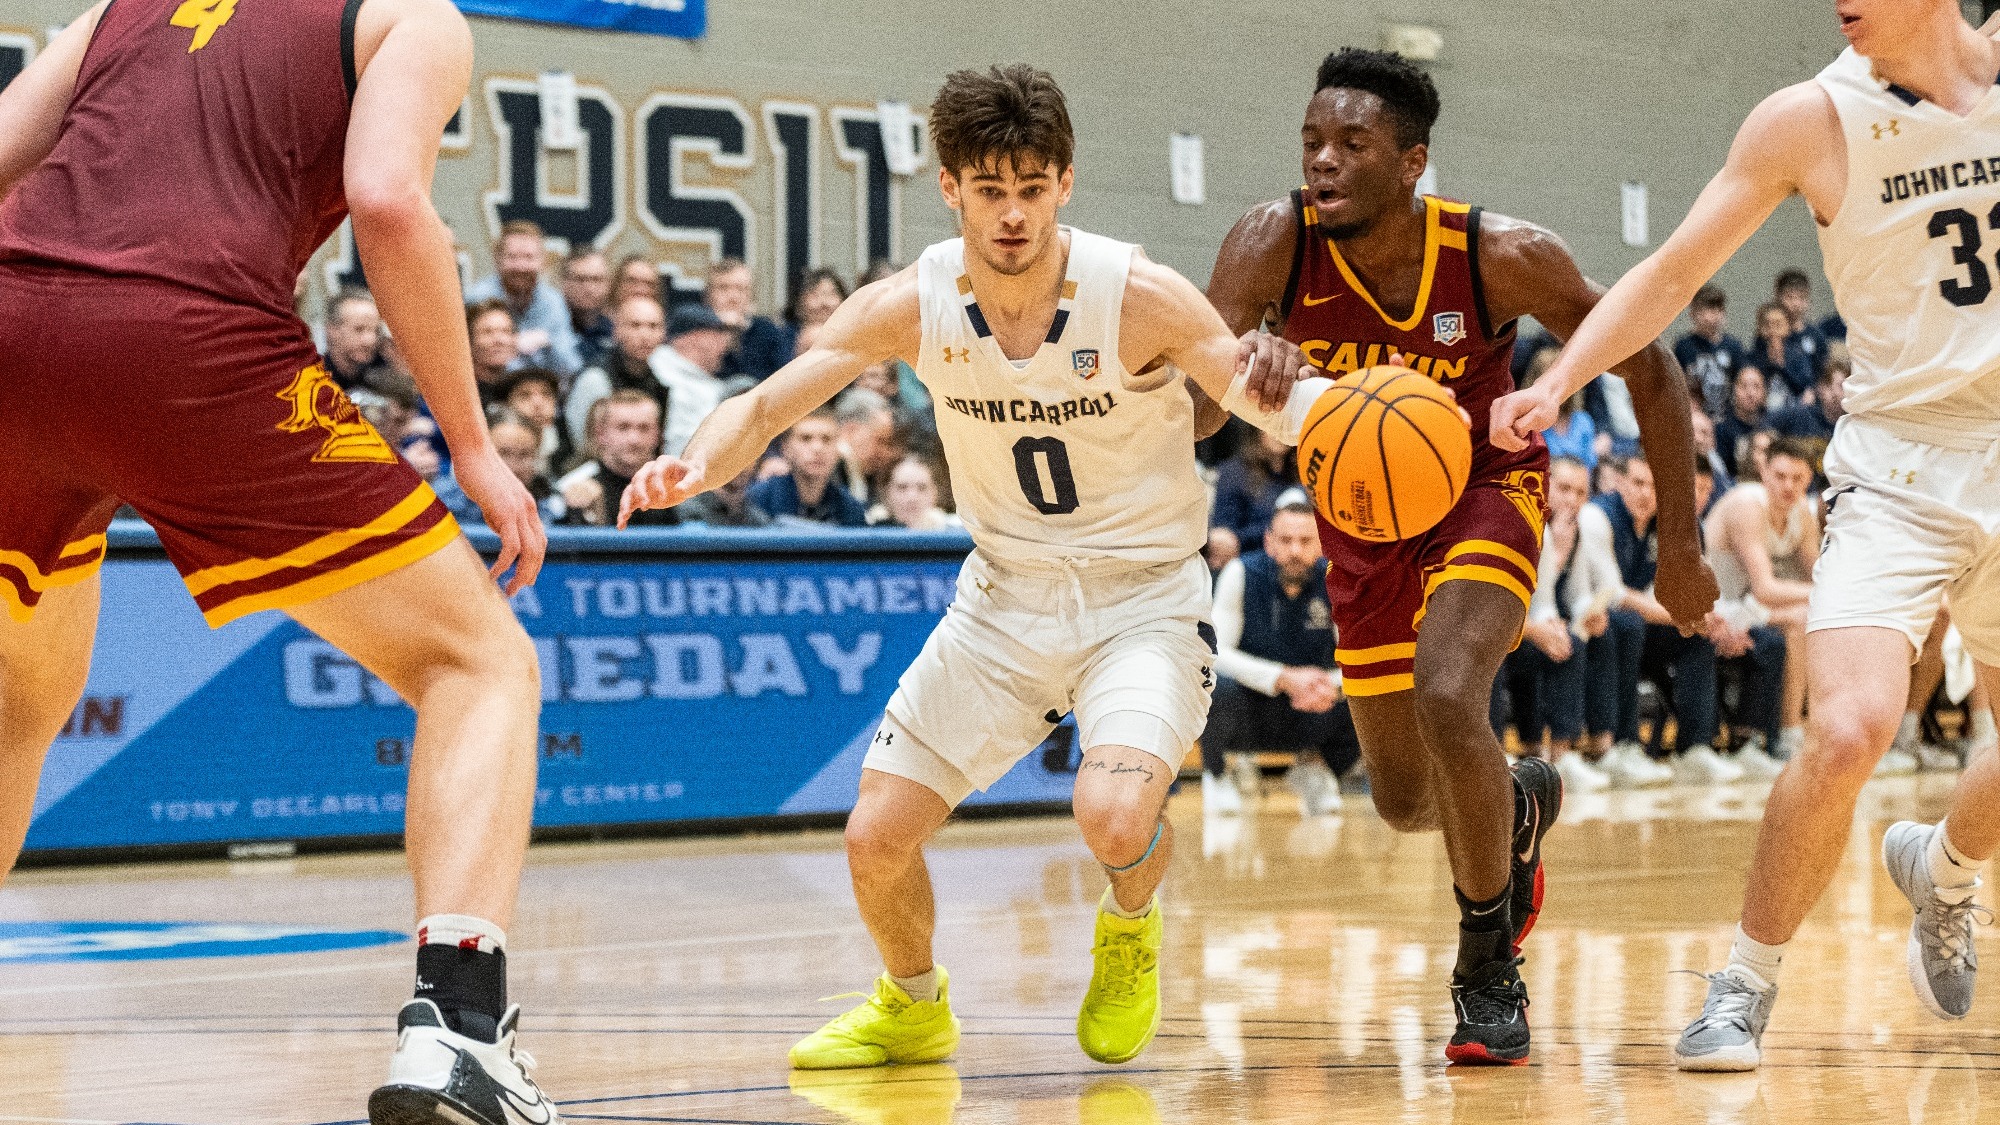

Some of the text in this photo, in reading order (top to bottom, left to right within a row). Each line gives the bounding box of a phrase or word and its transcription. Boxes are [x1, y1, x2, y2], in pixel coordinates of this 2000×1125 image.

[1881, 165, 1948, 204] JOHN
[1441, 321, 1457, 332] 50
[1077, 356, 1095, 368] 50
[944, 391, 1118, 425] JOHN CARROLL
[1012, 436, 1080, 515] 0
[283, 632, 882, 708] GEDAY
